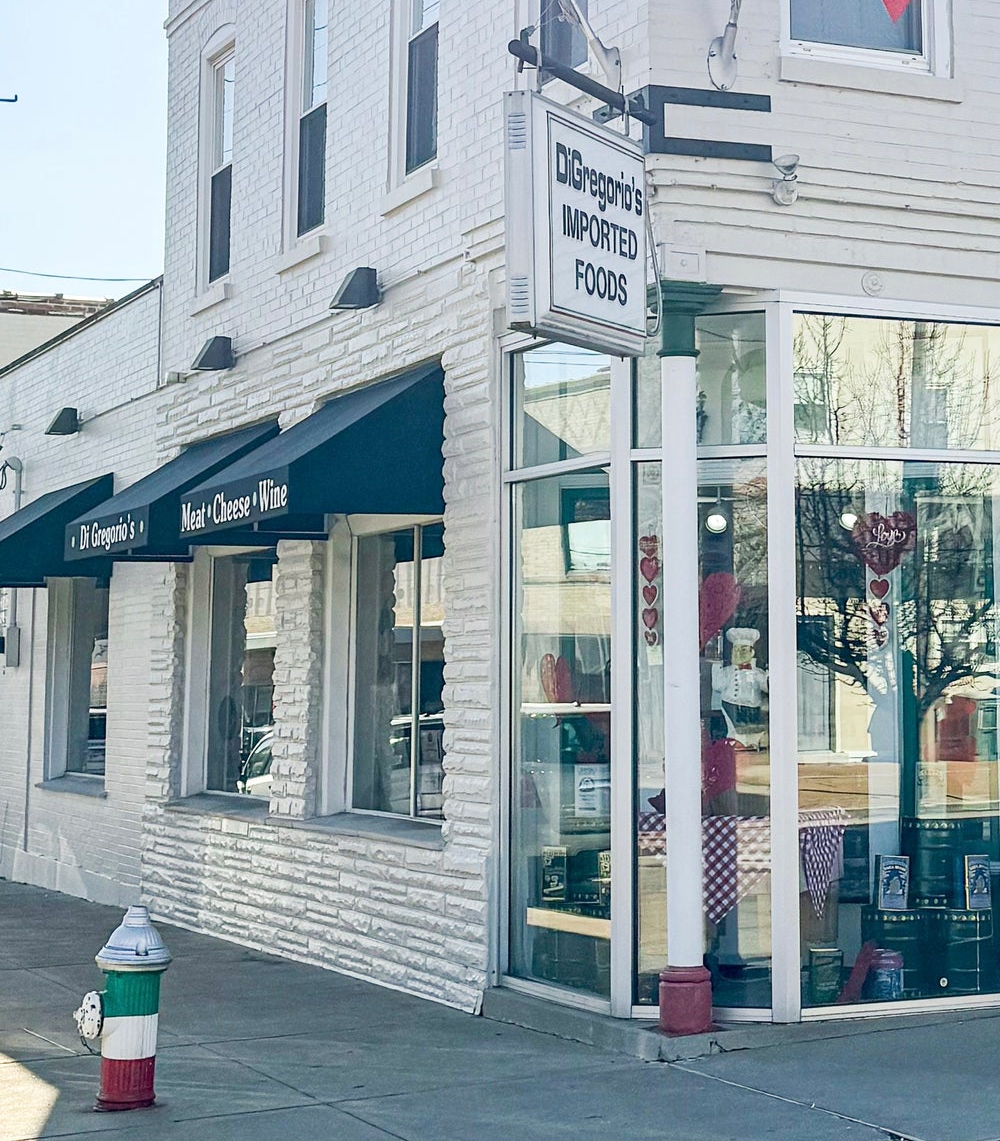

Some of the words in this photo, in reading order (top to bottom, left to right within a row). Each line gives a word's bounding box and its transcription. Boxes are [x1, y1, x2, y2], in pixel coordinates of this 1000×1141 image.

[555, 141, 643, 217] DiGregorio's
[562, 203, 638, 261] IMPORTED
[575, 258, 628, 306] FOODS
[79, 524, 90, 551] Di
[91, 514, 136, 551] Gregorio's
[180, 503, 206, 533] Meat
[211, 493, 251, 525] Cheese
[257, 478, 288, 513] Wine
